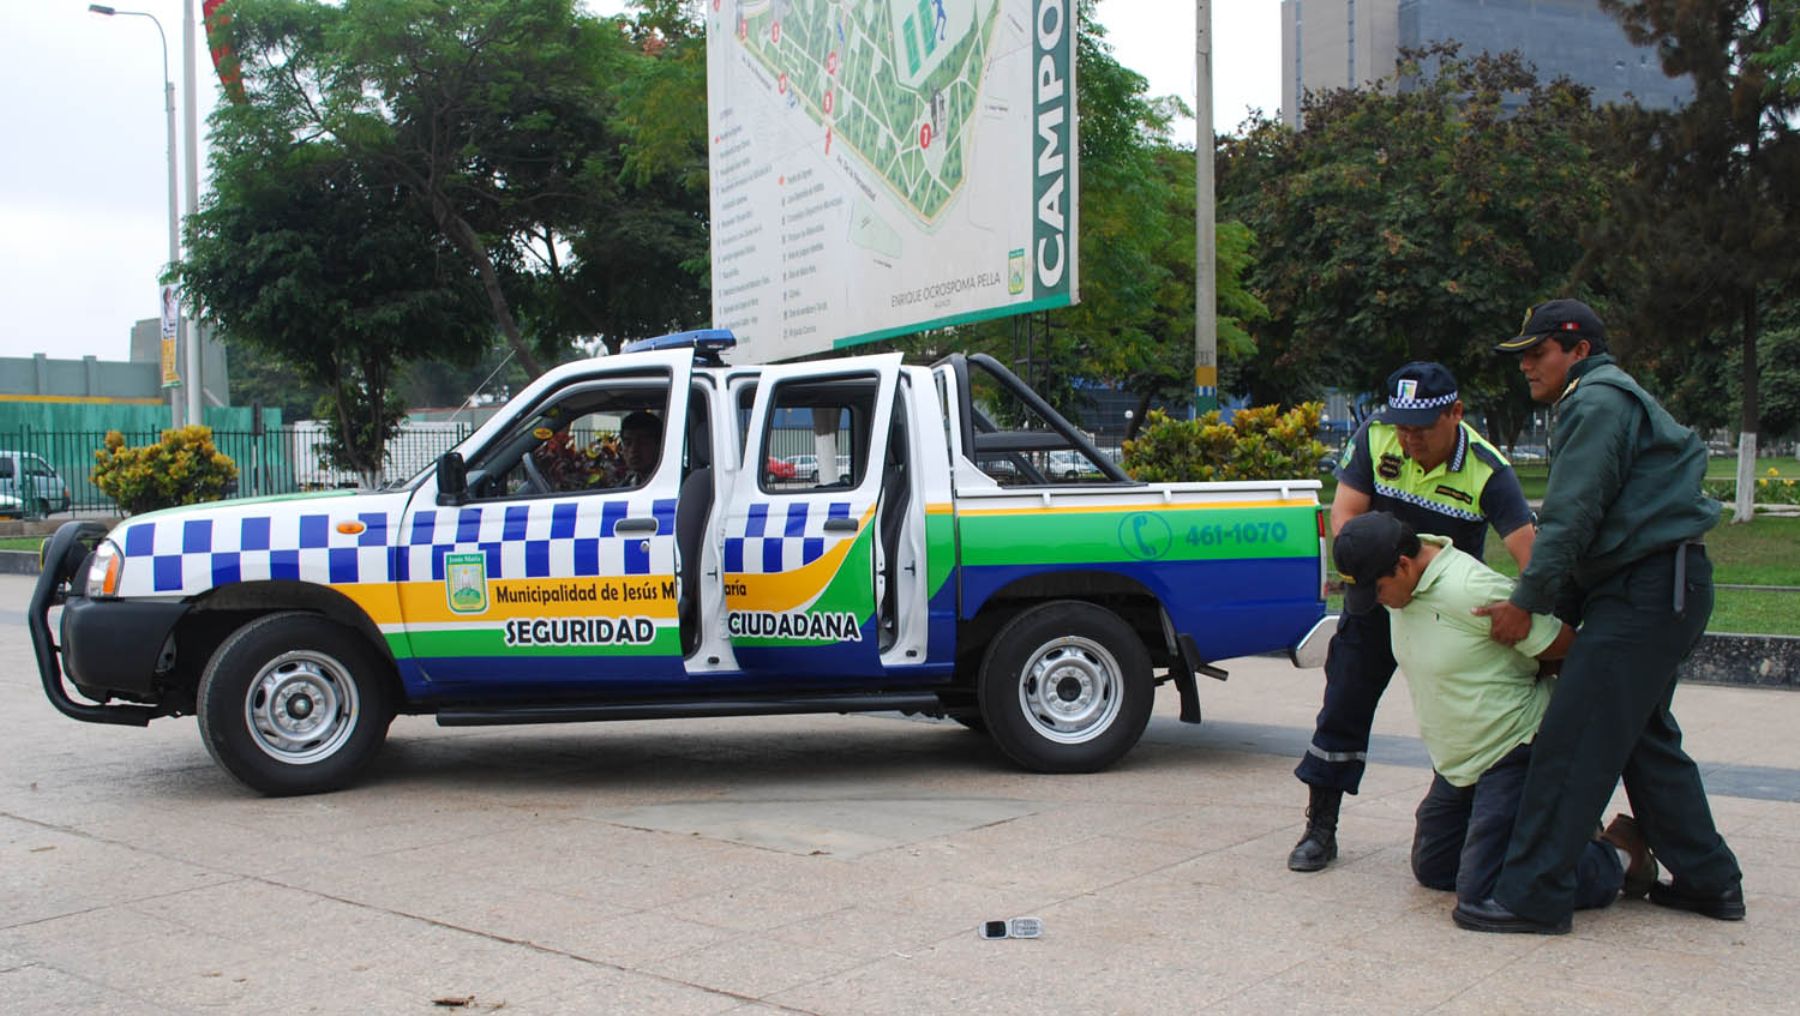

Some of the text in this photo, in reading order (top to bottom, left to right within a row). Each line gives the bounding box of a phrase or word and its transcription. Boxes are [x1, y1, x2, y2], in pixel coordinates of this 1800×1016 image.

[1037, 0, 1064, 288] CAMPO
[977, 271, 1001, 287] PELLA
[1185, 521, 1288, 547] 461-1070
[496, 582, 597, 606] Municipalidad
[600, 582, 618, 601] de
[623, 581, 658, 602] Jesús
[505, 617, 655, 645] SEGURIDAD
[727, 611, 861, 640] CIUDADANA
